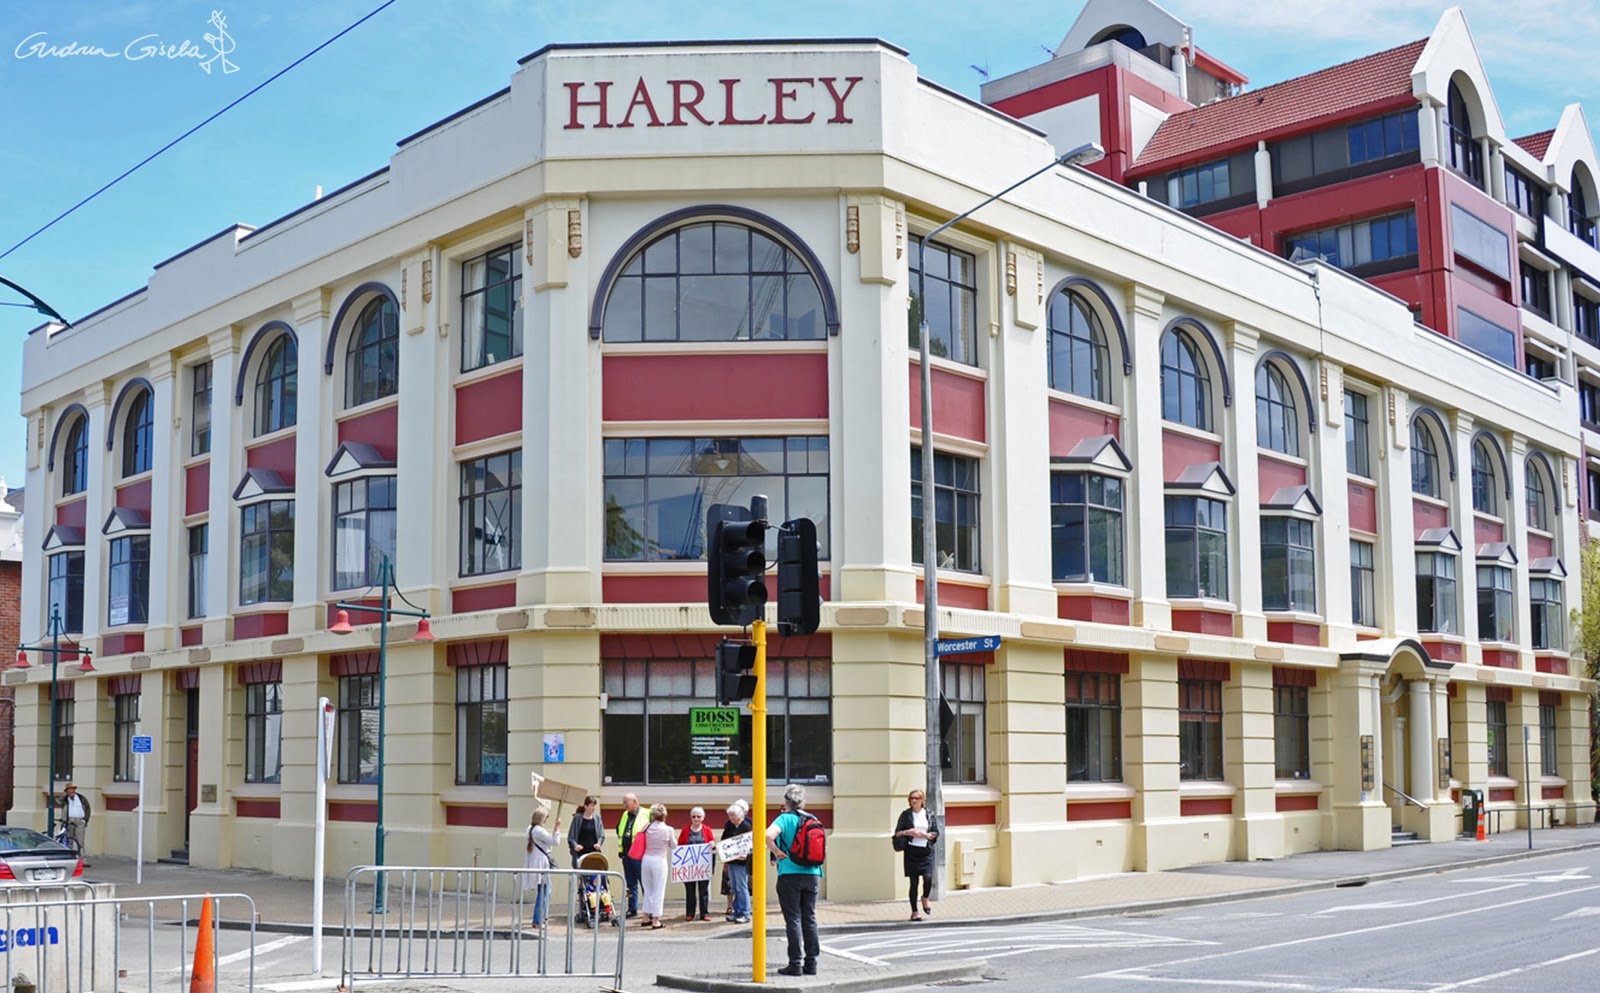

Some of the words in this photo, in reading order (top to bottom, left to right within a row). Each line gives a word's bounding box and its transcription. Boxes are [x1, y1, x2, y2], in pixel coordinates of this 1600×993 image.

[563, 75, 864, 130] HARLEY
[937, 640, 978, 652] Worcester
[983, 638, 994, 648] St
[696, 711, 734, 723] BOSS
[672, 844, 711, 866] SAVE
[672, 864, 710, 882] HERITAGE
